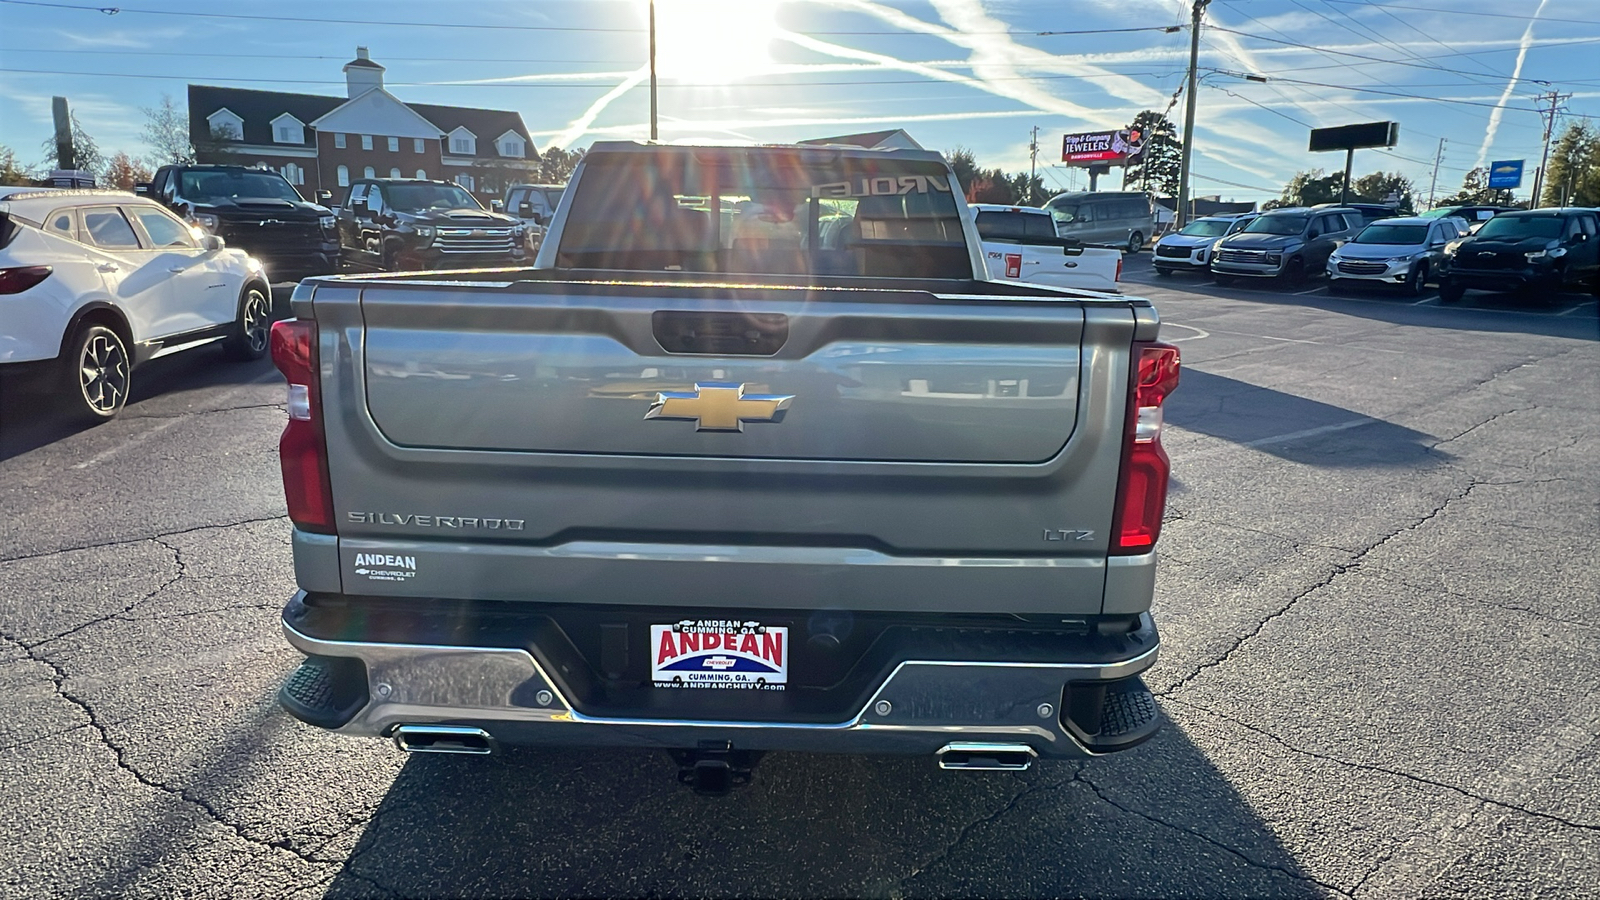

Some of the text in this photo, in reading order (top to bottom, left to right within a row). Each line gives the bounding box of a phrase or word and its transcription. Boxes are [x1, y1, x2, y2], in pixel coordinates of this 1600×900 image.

[1066, 142, 1109, 154] JEWELERS
[348, 511, 525, 531] SILVERADO
[1043, 529, 1095, 541] LTZ
[355, 553, 416, 570] ANDEAN
[697, 620, 741, 628] ANDEAN
[682, 626, 737, 635] CUMMING,
[657, 630, 783, 668] ANDEAN
[688, 673, 751, 682] CUMMING, GA.
[653, 682, 786, 691] www.ANDEANCHEVY.com
